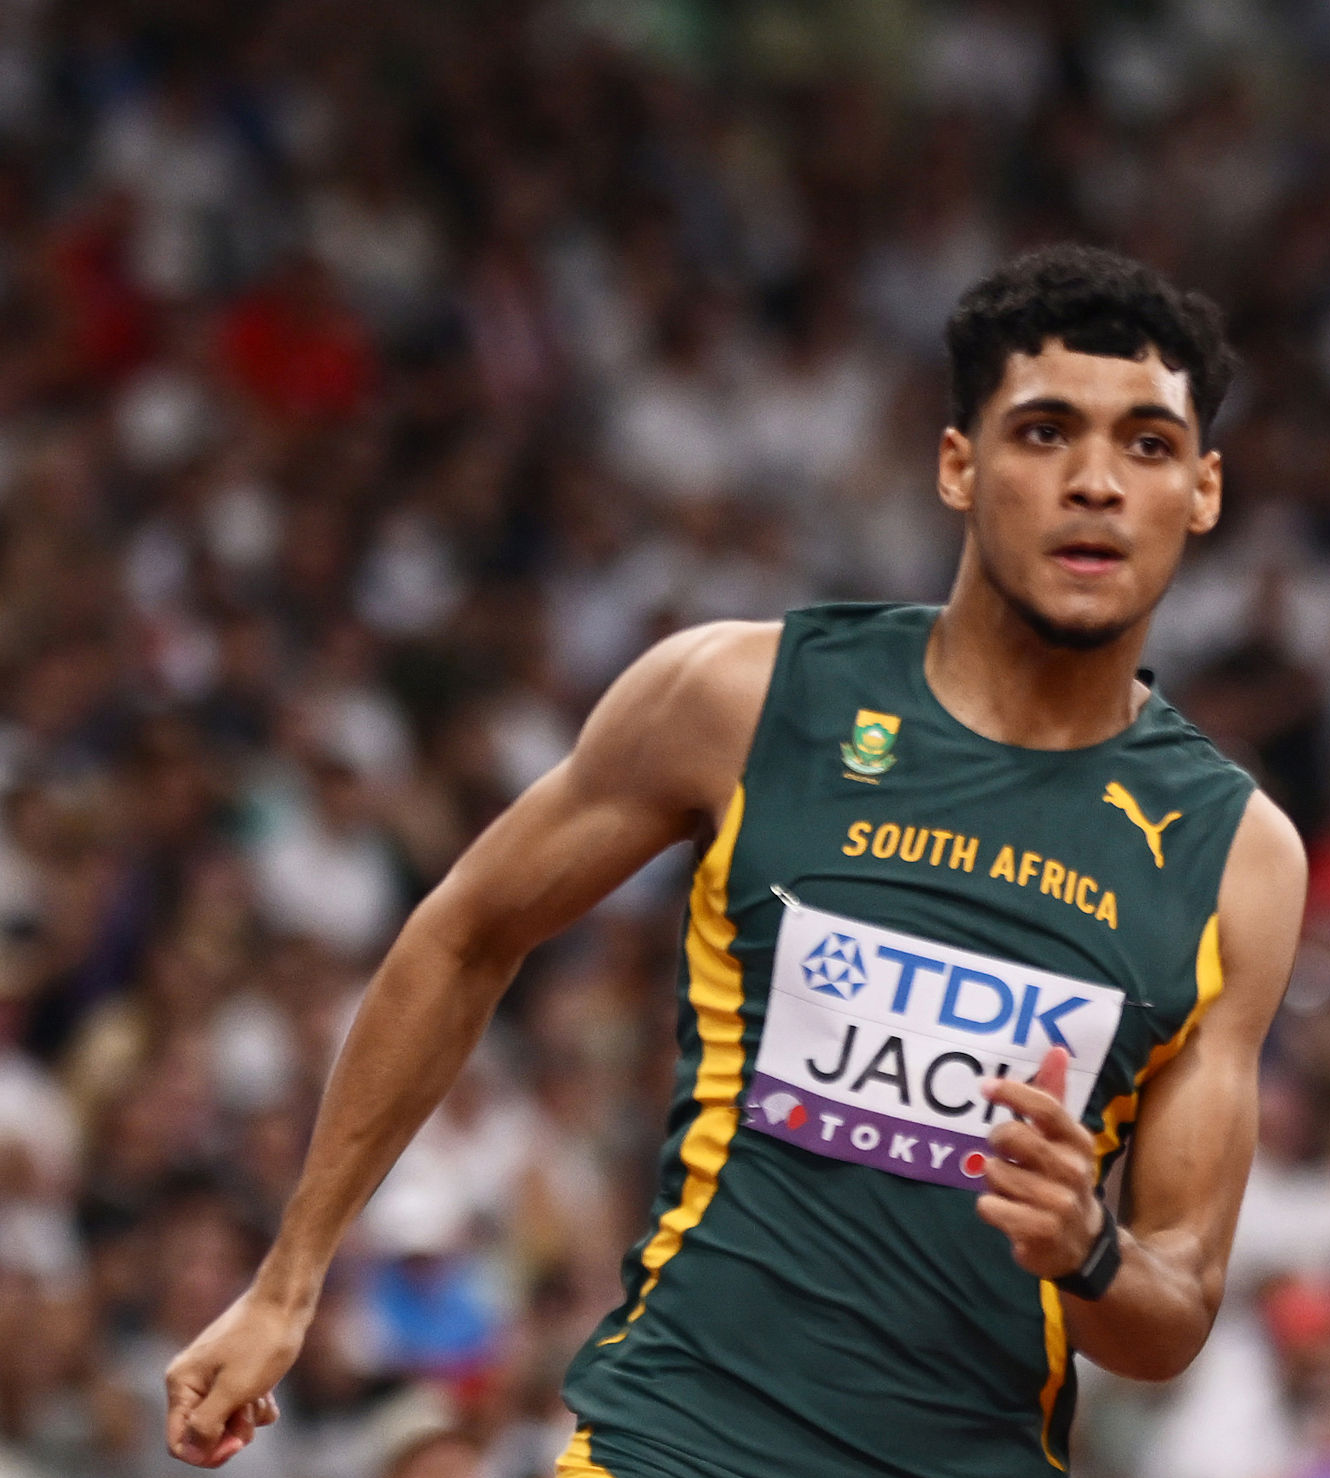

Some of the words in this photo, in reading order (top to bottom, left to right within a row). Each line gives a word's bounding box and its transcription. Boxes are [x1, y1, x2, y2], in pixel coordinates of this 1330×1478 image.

[842, 820, 980, 874] SOUTH
[989, 845, 1119, 931] AFRICA
[876, 944, 1092, 1059] TDK
